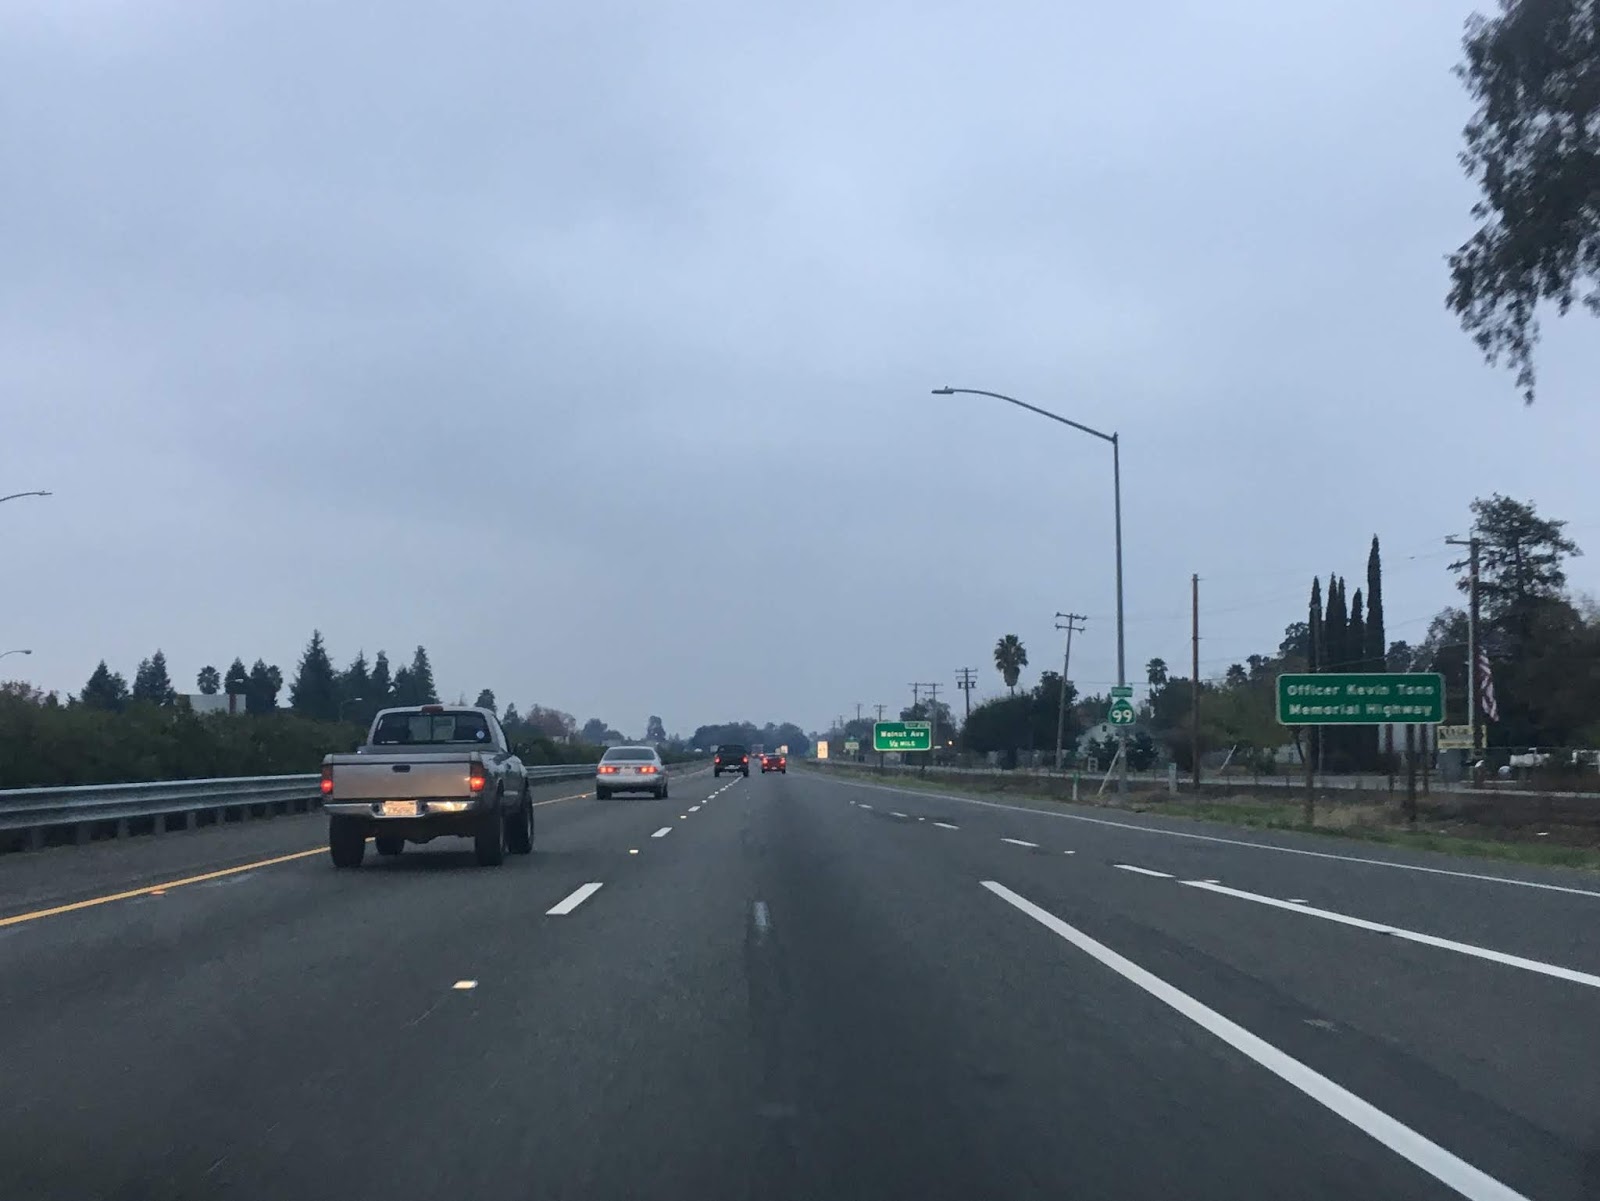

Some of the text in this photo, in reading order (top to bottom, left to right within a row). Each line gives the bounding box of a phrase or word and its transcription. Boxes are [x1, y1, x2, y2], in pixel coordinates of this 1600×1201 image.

[1287, 684, 1340, 696] Officer
[1346, 684, 1390, 696] Kevin
[1112, 710, 1133, 723] 99
[1289, 704, 1433, 717] Memorial Highway
